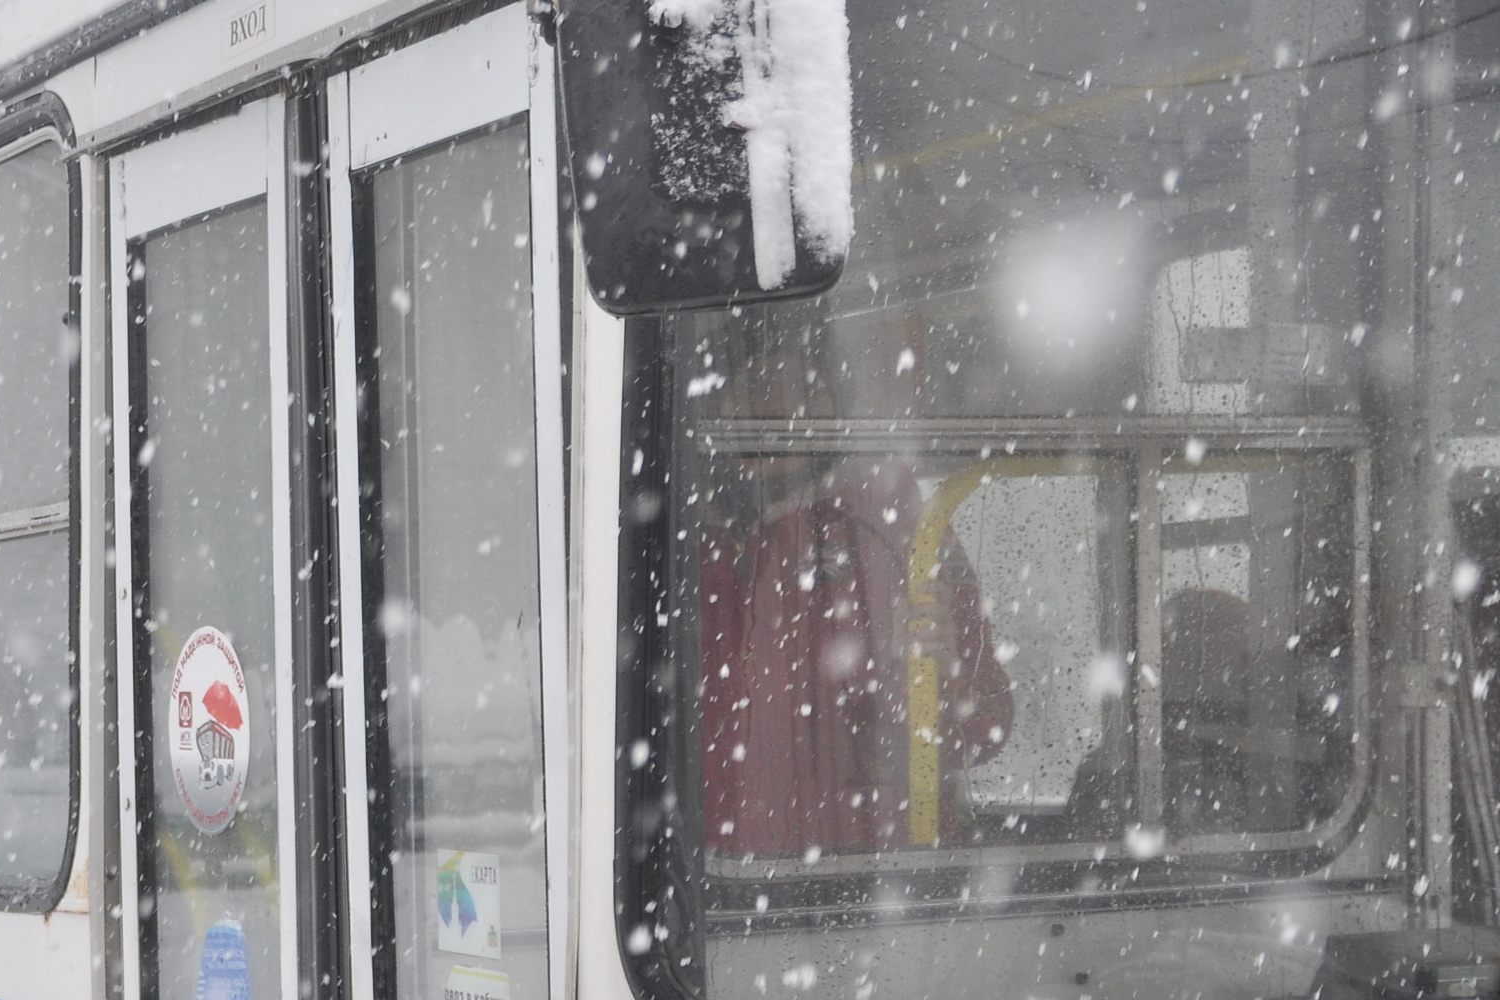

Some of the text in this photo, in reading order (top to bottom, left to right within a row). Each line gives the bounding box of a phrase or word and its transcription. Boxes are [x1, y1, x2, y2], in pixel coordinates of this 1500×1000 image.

[230, 5, 266, 47] ВХОД
[172, 632, 244, 699] ПОД НАДЕЖНОЙ ЗАЩИТОЙ
